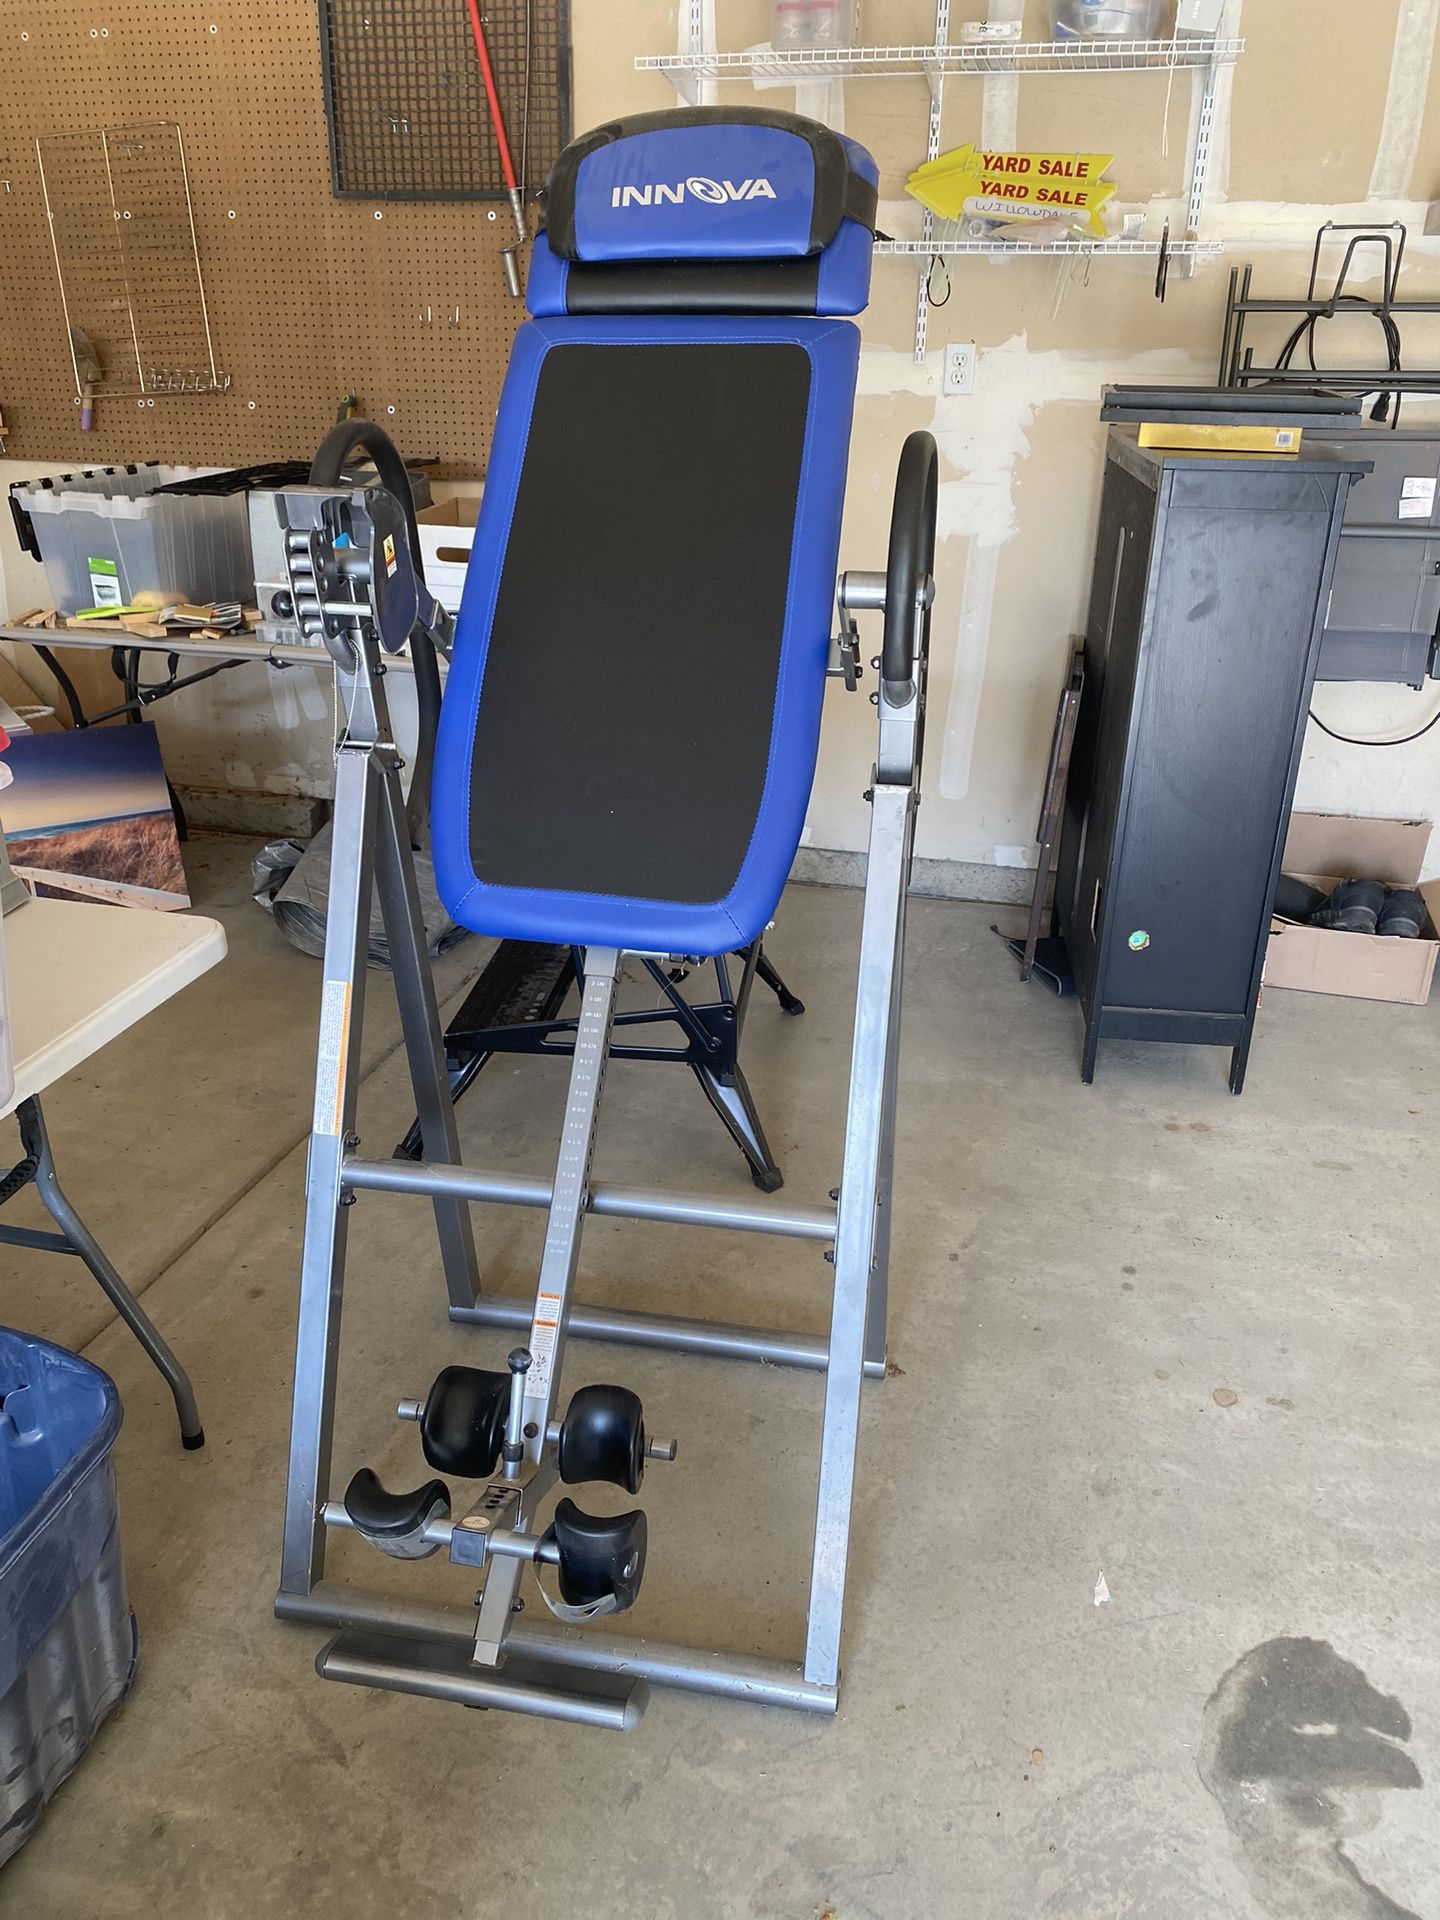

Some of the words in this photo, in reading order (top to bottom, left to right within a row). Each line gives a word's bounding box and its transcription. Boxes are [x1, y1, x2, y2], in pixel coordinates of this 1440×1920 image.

[982, 154, 1031, 174] YARD
[1038, 159, 1090, 178] SALE
[611, 176, 777, 208] INNOVA
[980, 180, 1029, 199] YARD
[1036, 187, 1089, 206] SALE
[975, 200, 1078, 217] WILLOWDA
